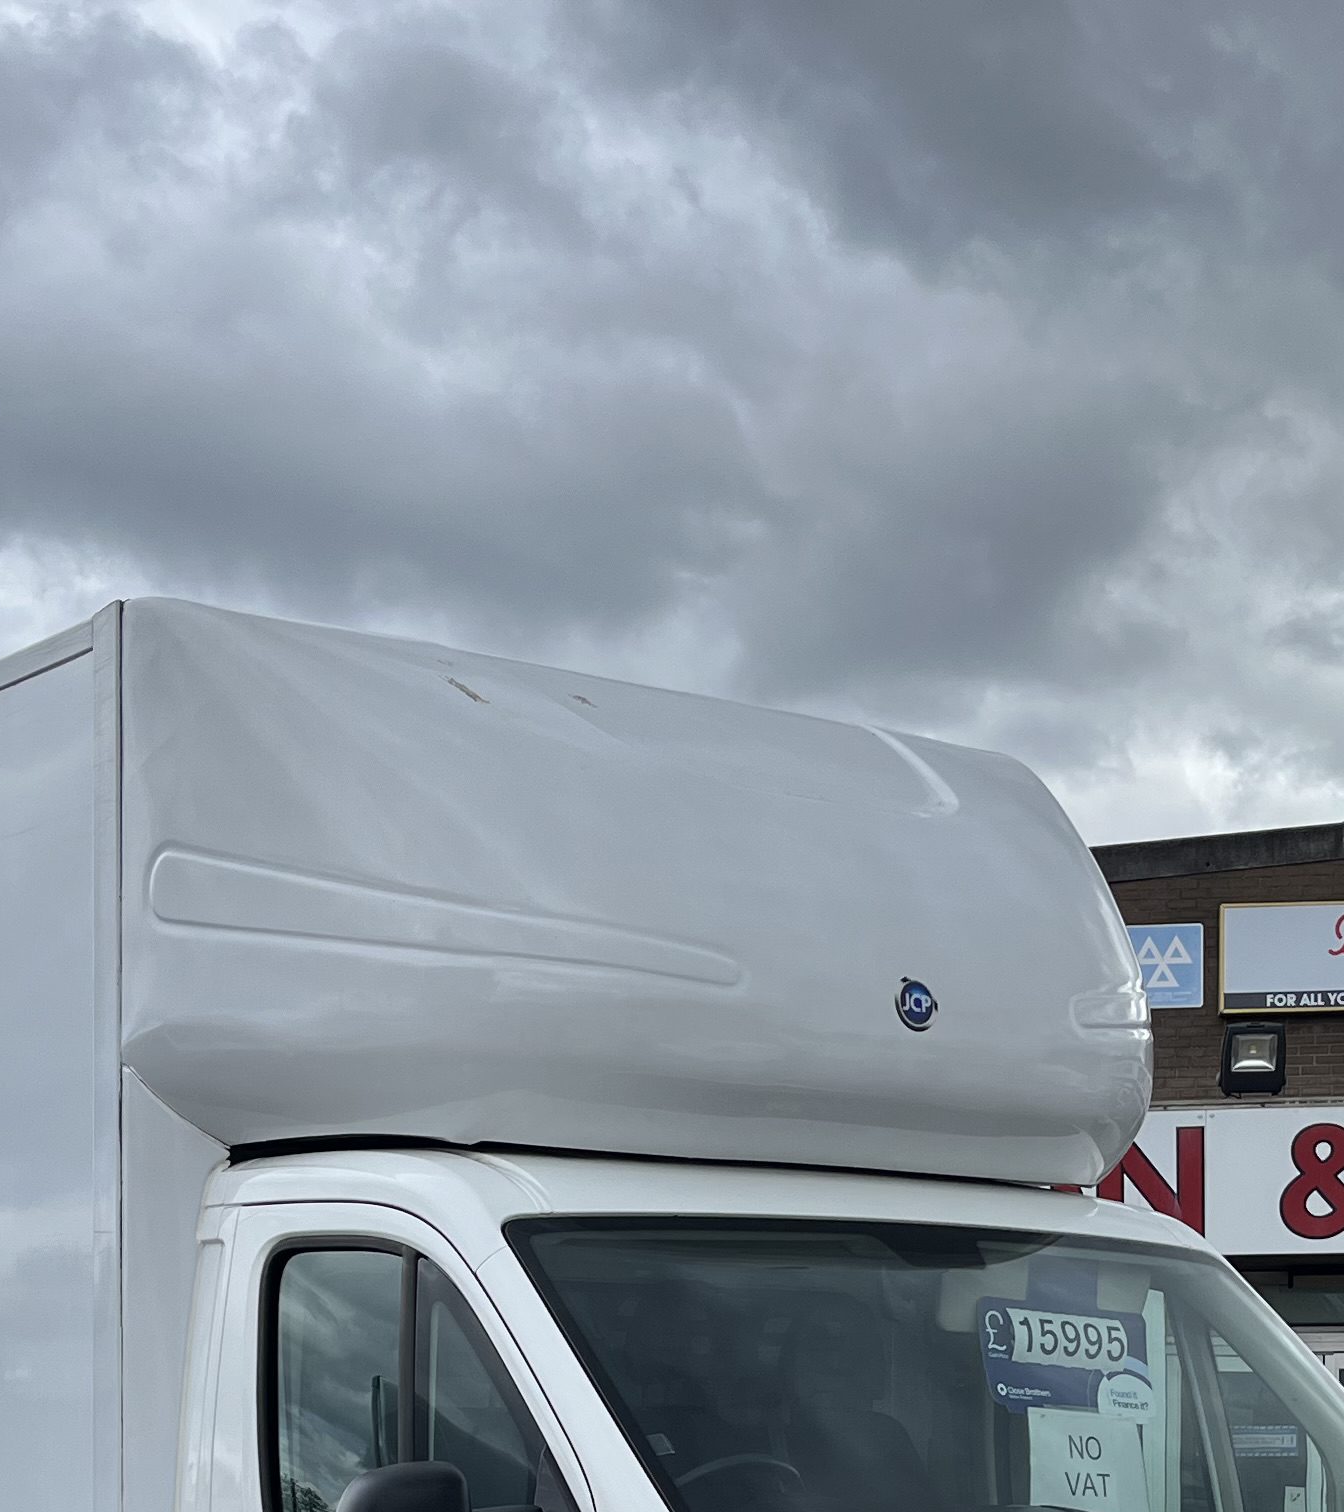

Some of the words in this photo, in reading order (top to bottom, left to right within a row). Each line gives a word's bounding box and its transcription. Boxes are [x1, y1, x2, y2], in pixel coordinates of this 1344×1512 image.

[1266, 994, 1297, 1007] FOR
[1299, 993, 1325, 1006] ALL
[1068, 1434, 1102, 1460] NO
[1064, 1471, 1111, 1497] VAT
